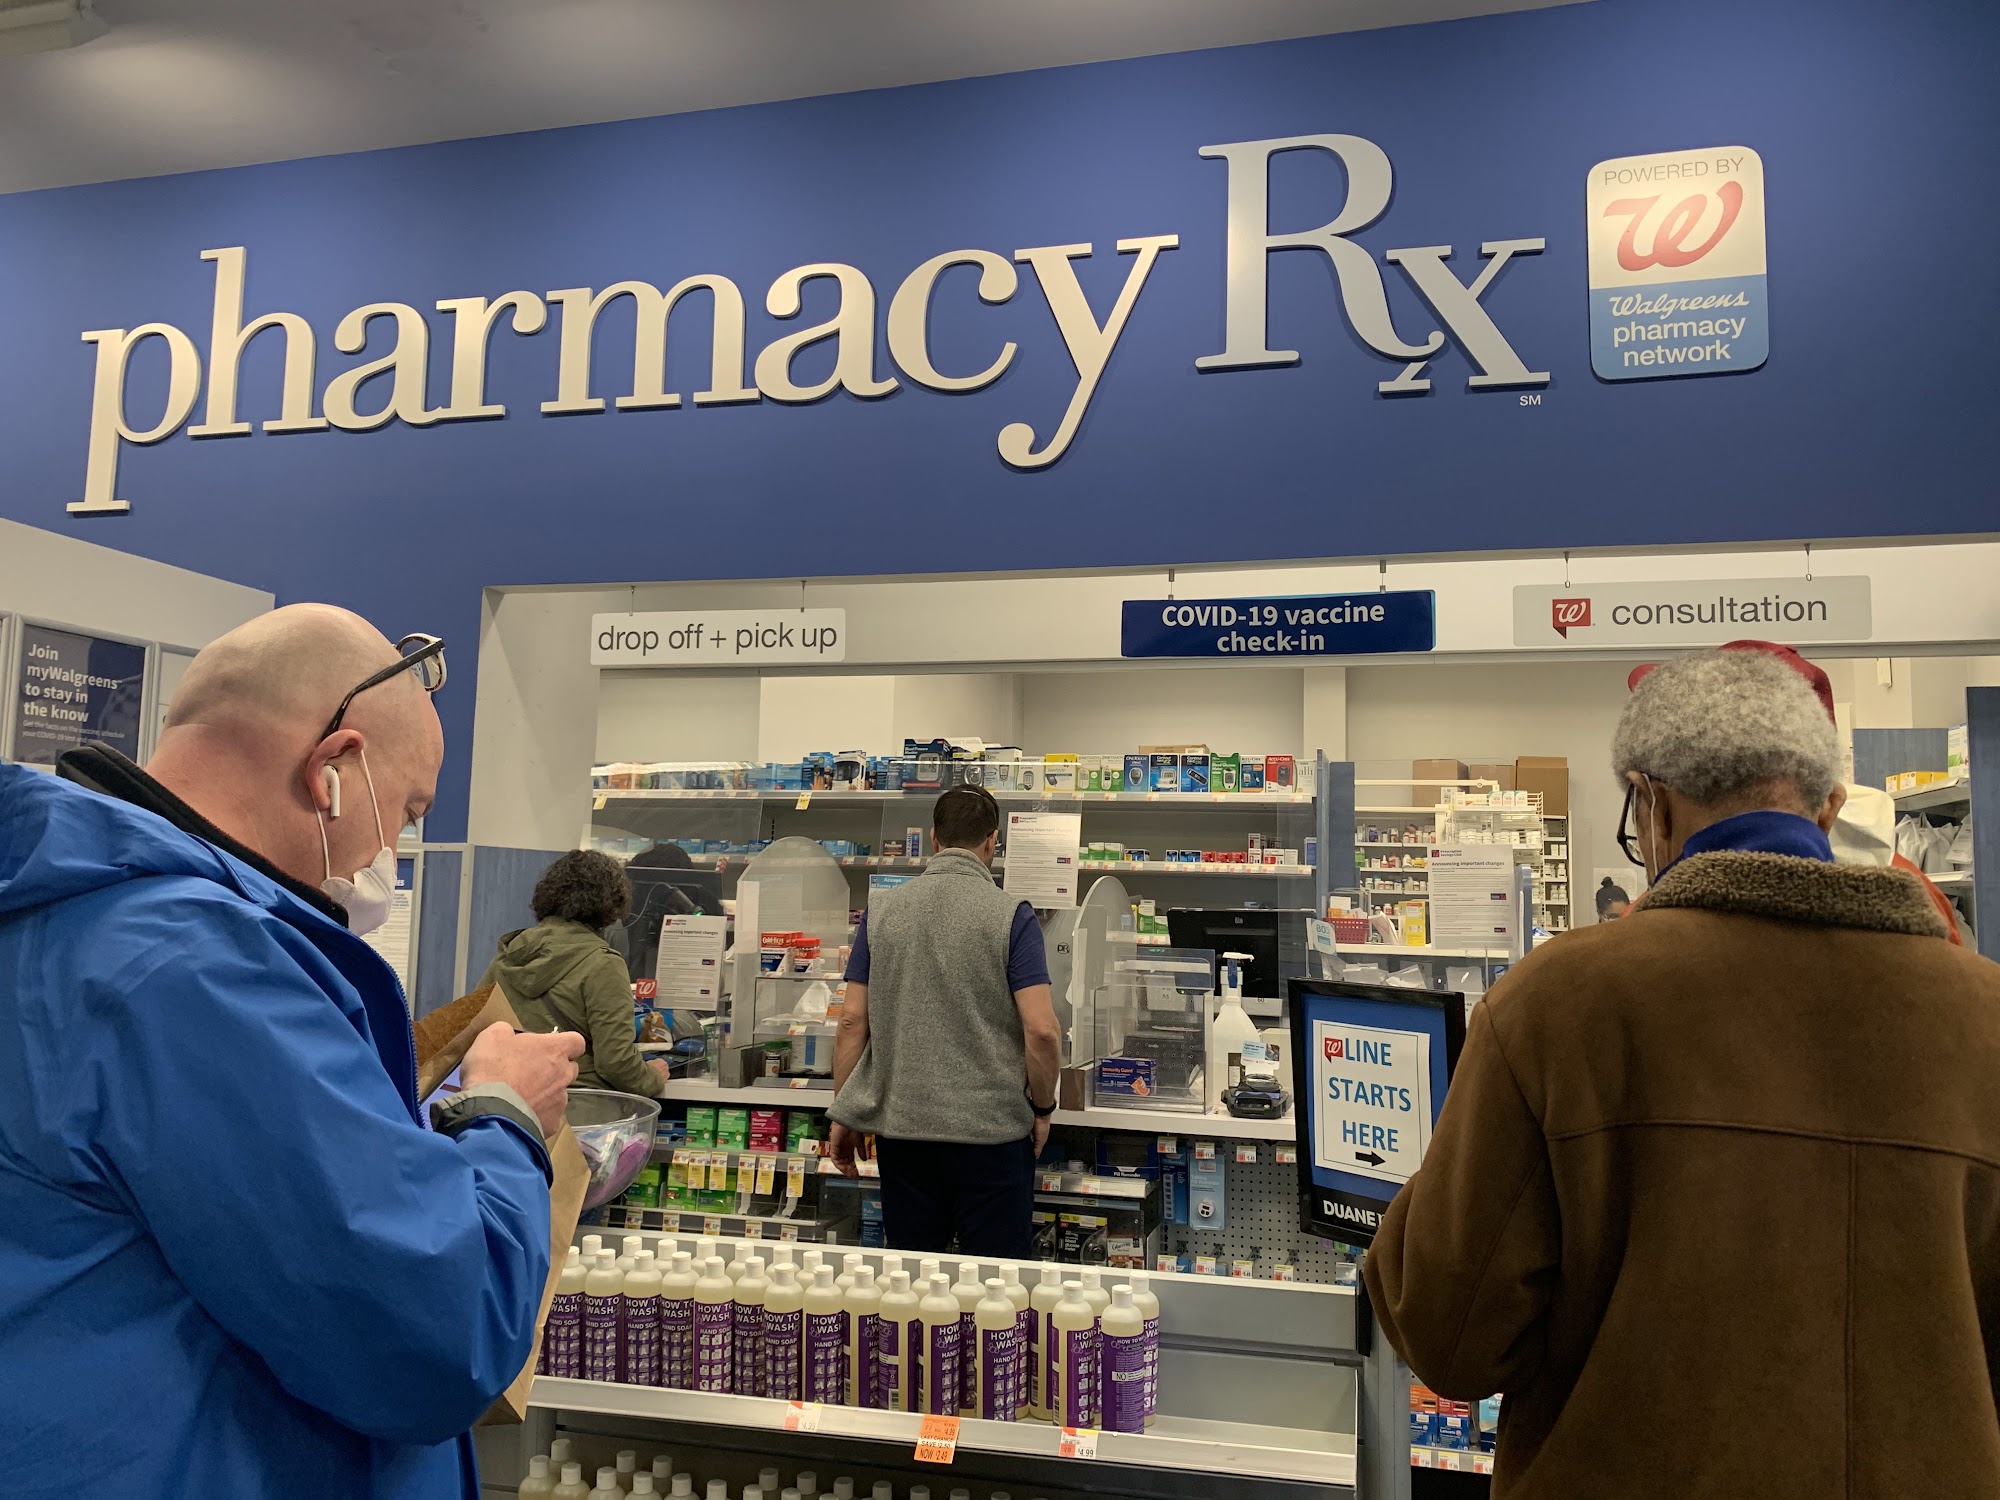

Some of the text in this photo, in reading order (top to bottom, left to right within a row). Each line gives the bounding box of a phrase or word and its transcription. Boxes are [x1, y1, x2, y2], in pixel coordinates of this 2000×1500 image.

[1604, 157, 1744, 186] POWERED BY
[1609, 291, 1750, 320] Walgreens
[66, 133, 1550, 513] pharmacy Rx
[1613, 317, 1746, 348] pharmacy
[1623, 340, 1732, 367] network
[1518, 394, 1542, 406] SM
[1161, 600, 1385, 627] COVID-19 vaccine
[1611, 594, 1827, 626] consultation
[598, 625, 659, 656] drop
[668, 623, 704, 650] off
[736, 622, 794, 655] pick
[801, 627, 838, 654] up
[1216, 629, 1325, 652] check-in
[28, 644, 59, 660] Join
[26, 665, 118, 689] myWalgreens
[25, 682, 88, 703] to stay in
[23, 702, 89, 722] the know
[1345, 1037, 1393, 1067] LINE
[1328, 1076, 1412, 1112] STARTS
[1342, 1120, 1399, 1153] HERE
[1323, 1200, 1377, 1228] DUANE
[553, 1295, 583, 1304] OW TO
[585, 1296, 619, 1306] HOW TO
[626, 1299, 648, 1307] HOW
[662, 1301, 680, 1309] HOW
[551, 1304, 578, 1313] WASH
[586, 1306, 614, 1315] WASH
[630, 1307, 658, 1316] WASH
[663, 1309, 690, 1318] WASH
[698, 1302, 733, 1314] HOW TO
[702, 1312, 730, 1322] WASH
[736, 1314, 763, 1323] WASH
[764, 1312, 800, 1322] HOW TO
[812, 1316, 837, 1325] HOW
[1020, 1311, 1028, 1320] TO
[766, 1323, 795, 1331] WASH
[991, 1330, 1013, 1340] HOW
[942, 1350, 956, 1358] HAND
[920, 1448, 934, 1460] NOW
